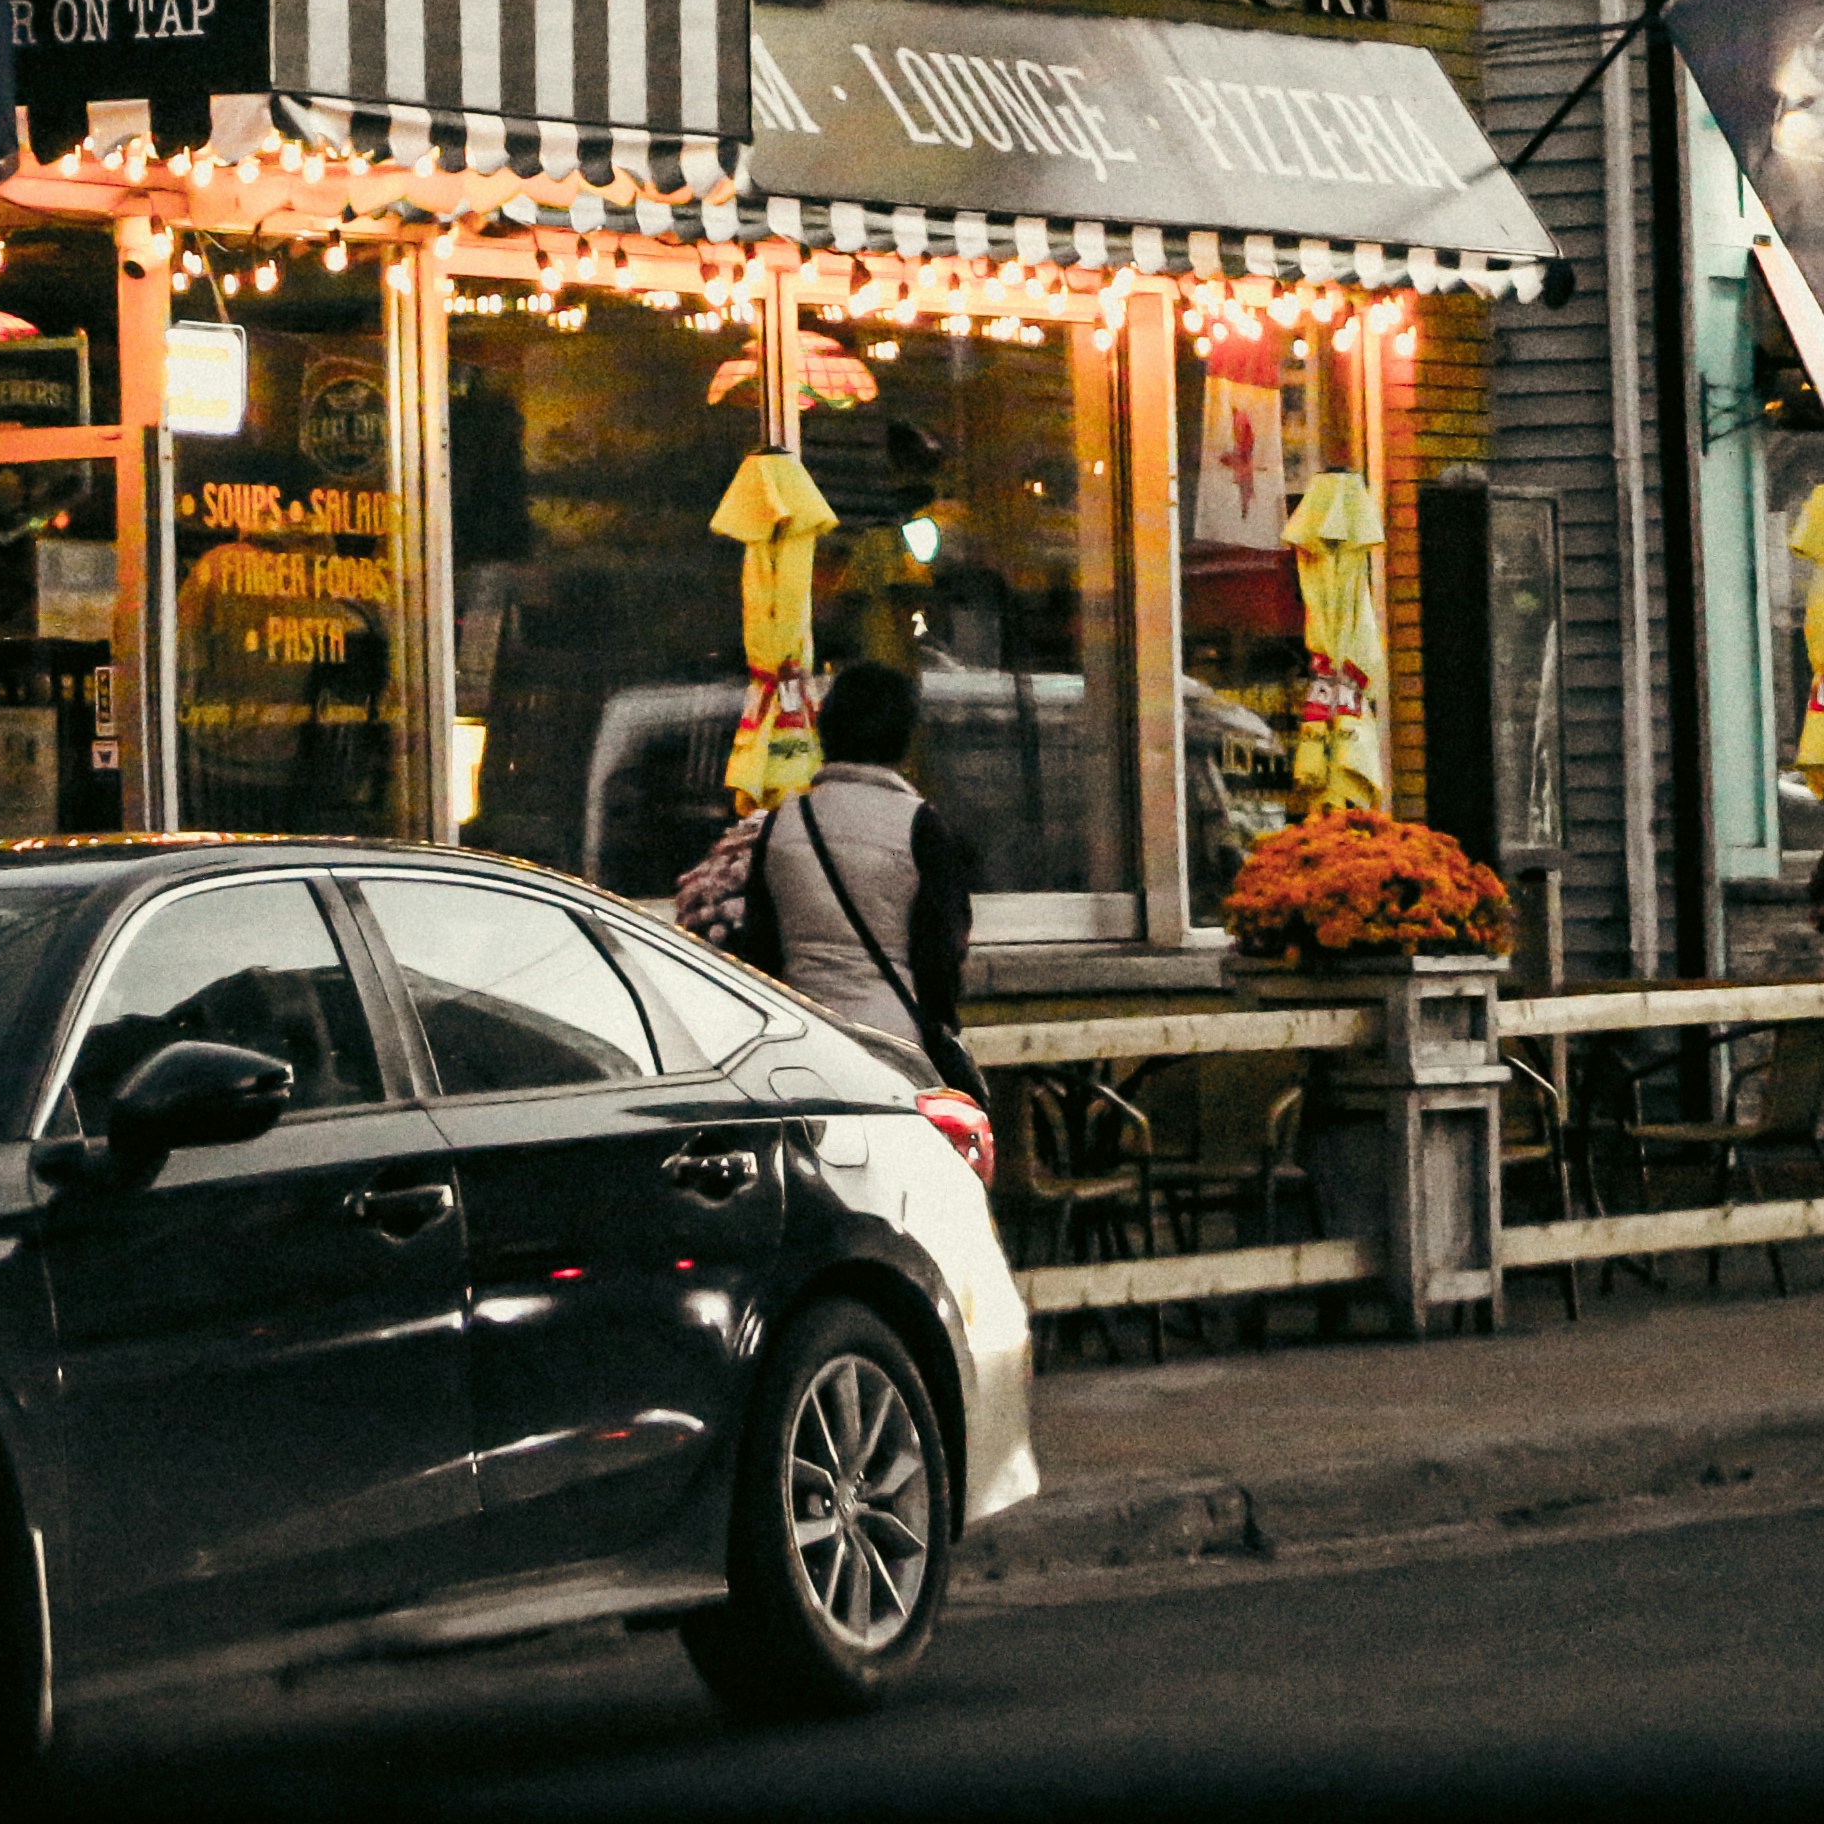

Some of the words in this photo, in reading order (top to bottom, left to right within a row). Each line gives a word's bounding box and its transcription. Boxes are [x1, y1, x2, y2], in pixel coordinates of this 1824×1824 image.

[852, 44, 1138, 181] LOUNGE
[1166, 76, 1468, 191] PIZZERIA
[202, 481, 283, 529] SOUPS
[220, 551, 307, 598] FINGER
[314, 557, 389, 602] FOODS
[266, 616, 345, 664] PASTA
